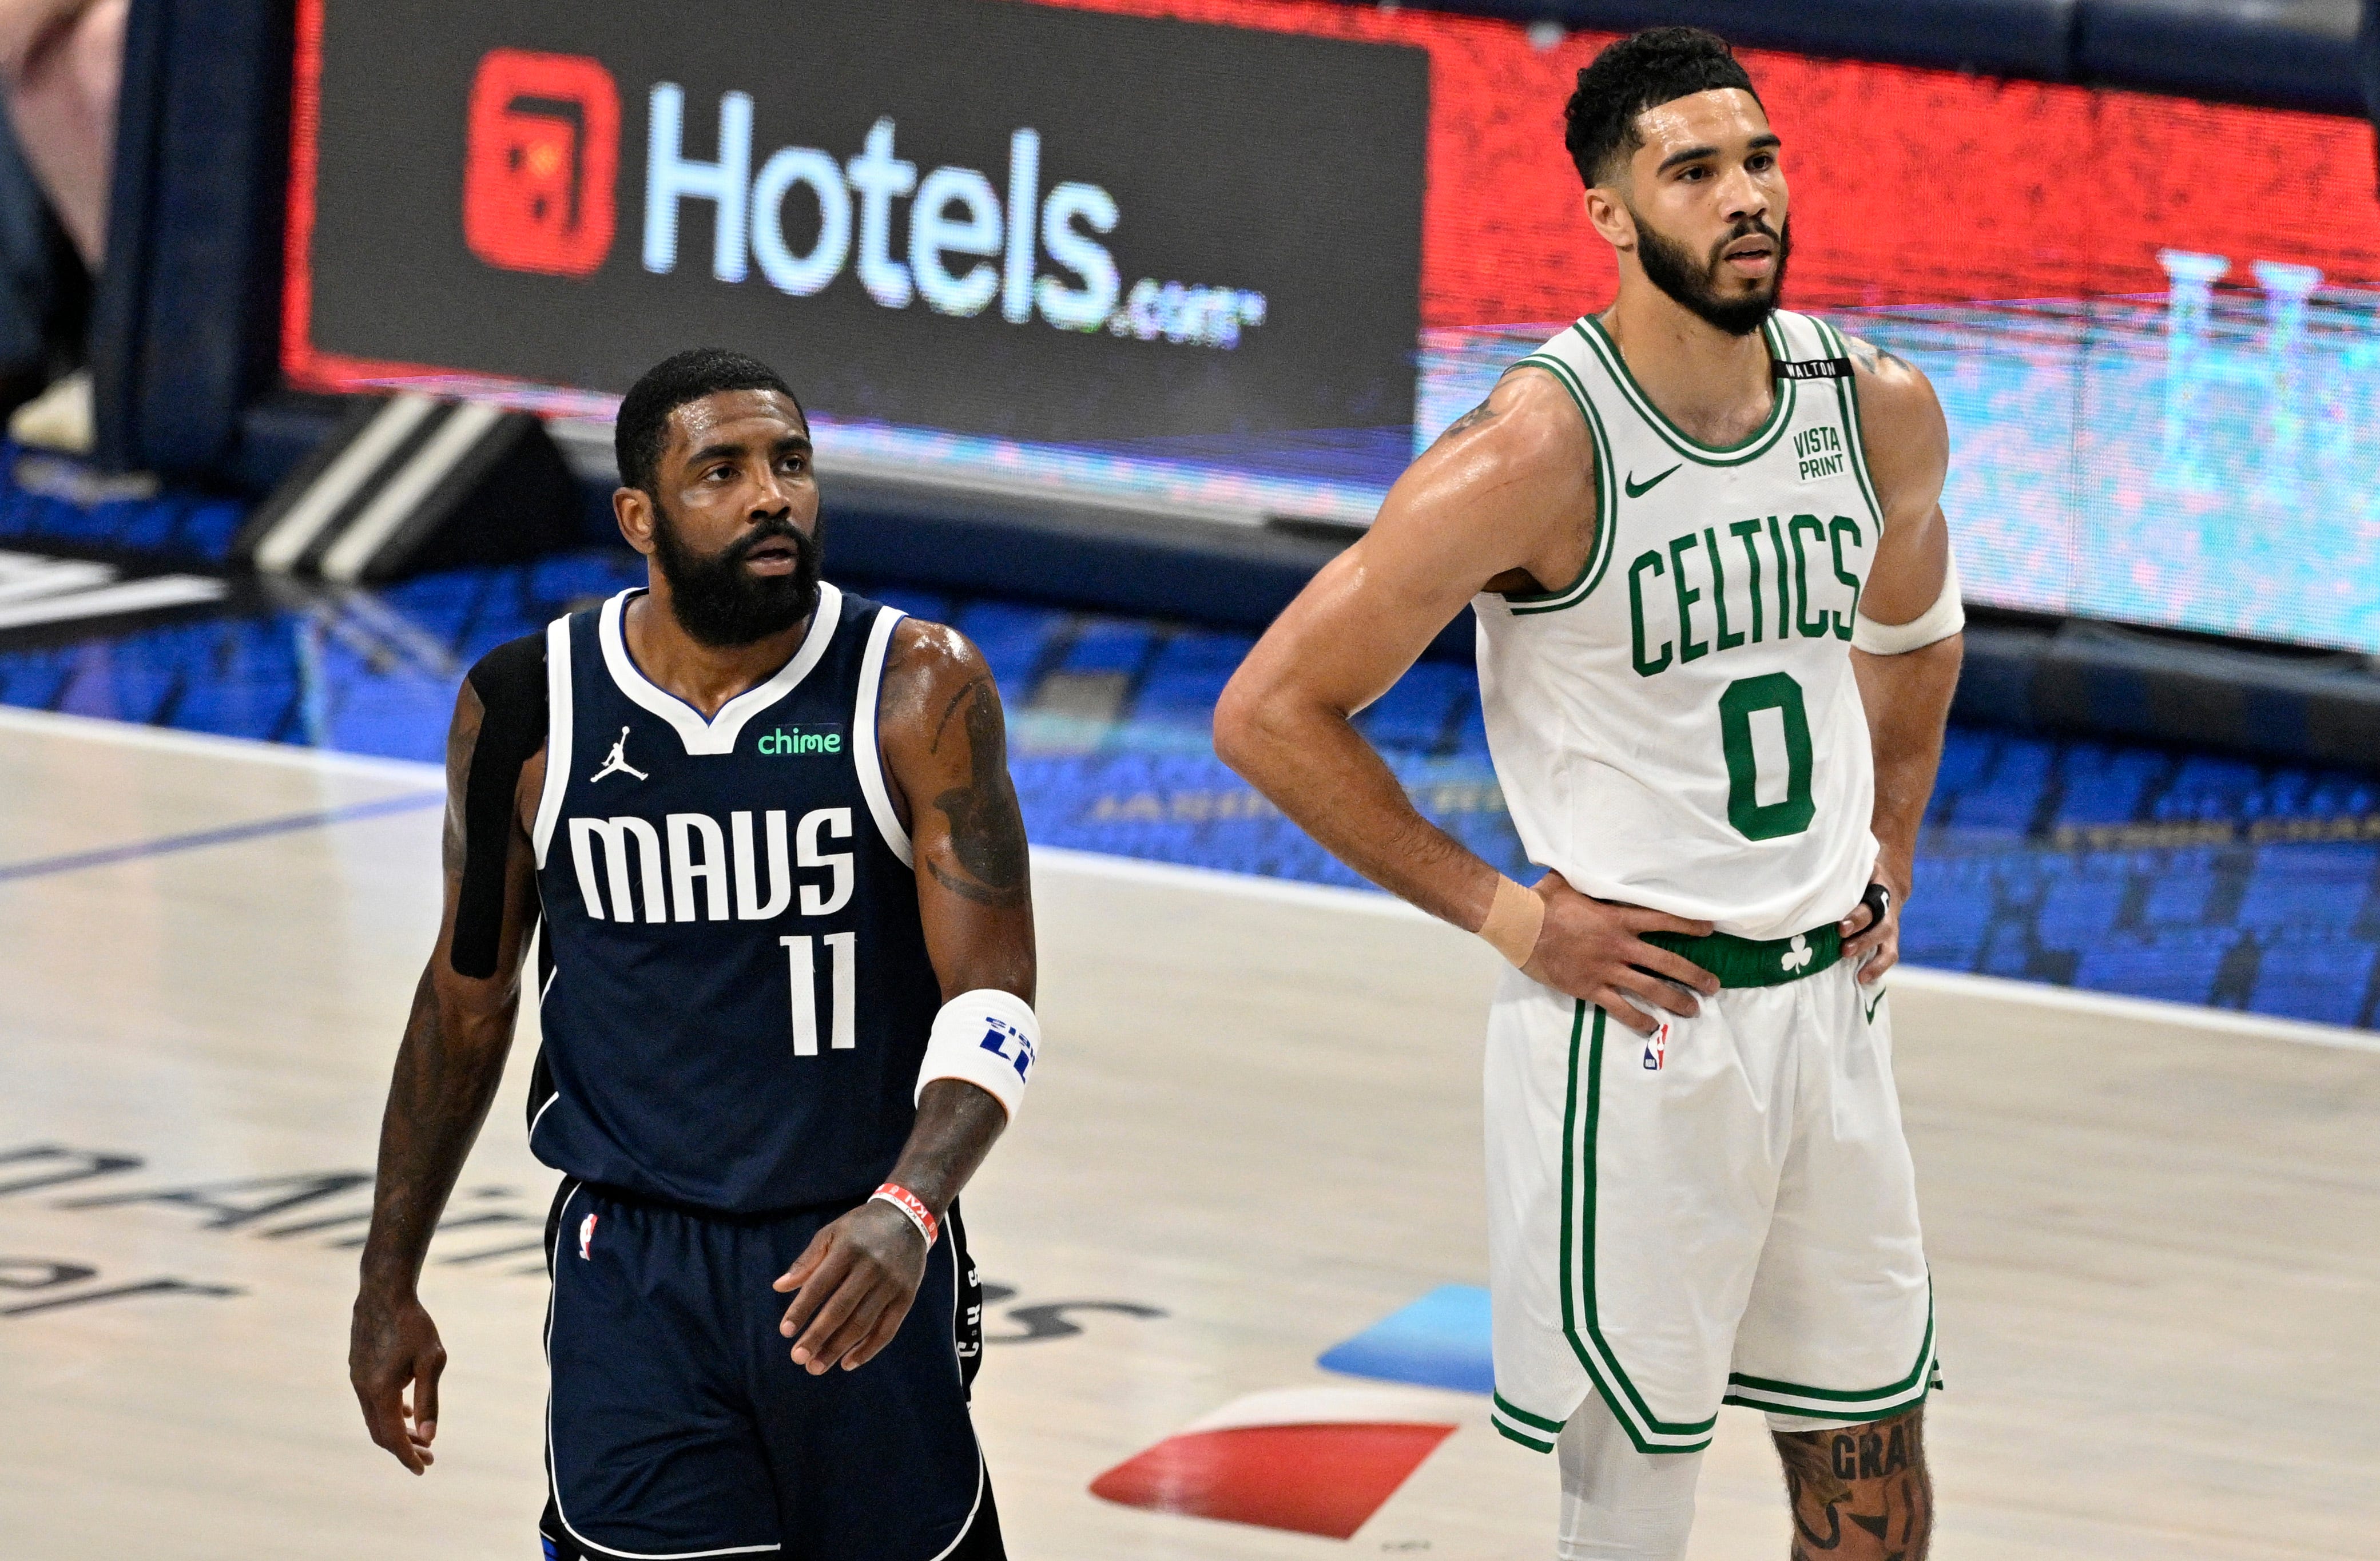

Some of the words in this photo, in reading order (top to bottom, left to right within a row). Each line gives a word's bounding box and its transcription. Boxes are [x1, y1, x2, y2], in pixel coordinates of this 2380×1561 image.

[1785, 361, 1837, 378] WALTON
[1793, 426, 1842, 459] VISTA
[1798, 453, 1843, 480] PRINT
[1628, 514, 1862, 678] CELTICS
[758, 728, 841, 754] chime
[1718, 671, 1816, 841] 0
[569, 807, 855, 923] MAVS
[779, 932, 856, 1056] 11
[904, 1193, 928, 1220] KAI
